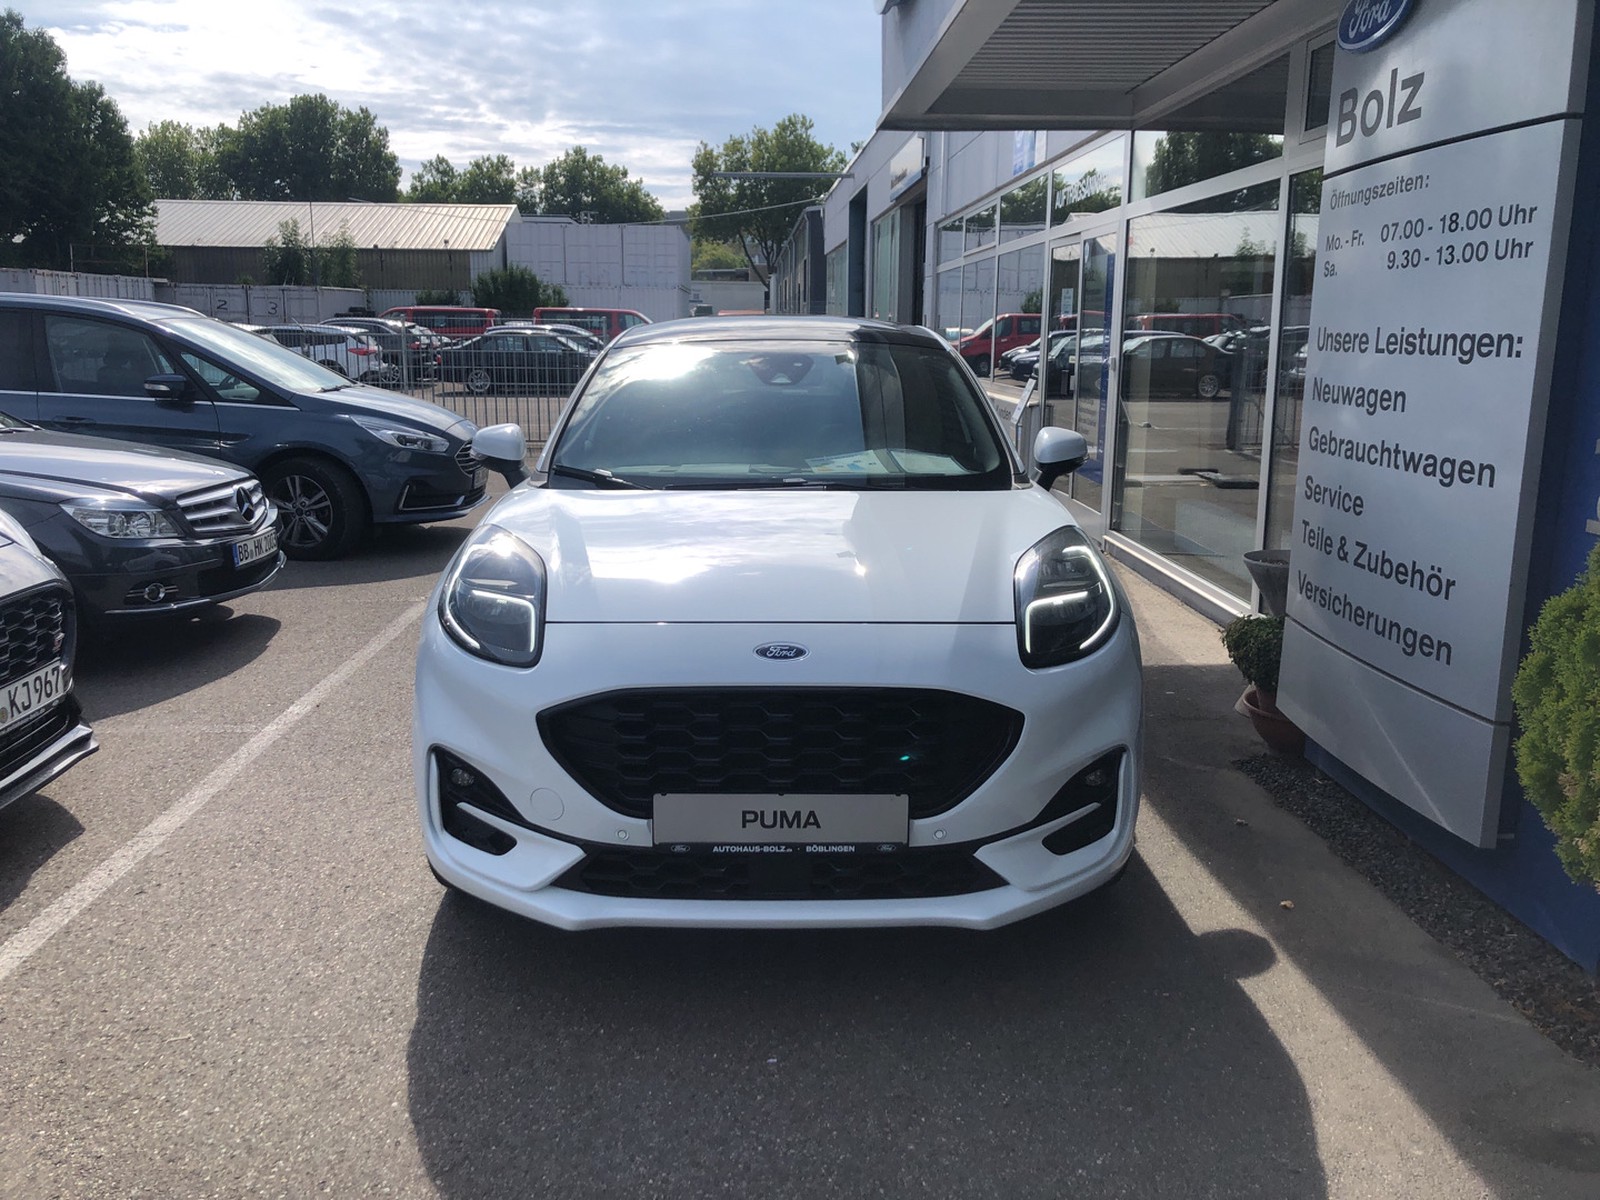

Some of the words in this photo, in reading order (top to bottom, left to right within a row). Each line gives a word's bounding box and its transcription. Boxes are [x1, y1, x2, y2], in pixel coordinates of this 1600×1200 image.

[1335, 67, 1425, 148] Bolz
[1330, 174, 1430, 210] Öffnungszeiten:
[1380, 217, 1425, 243] 07.00
[1439, 207, 1493, 235] 18.00
[1498, 204, 1538, 227] Uhr
[1323, 260, 1338, 278] Sa.
[1386, 249, 1421, 270] 9.30
[1436, 241, 1489, 267] 13.00
[1494, 238, 1534, 260] Uhr
[216, 299, 228, 311] 2
[267, 301, 279, 316] 3
[1316, 326, 1370, 354] Unsere
[1374, 326, 1523, 366] Leistungen:
[1311, 376, 1407, 417] Neuwagen
[1308, 425, 1496, 489] Gebrauchtwagen
[1304, 474, 1365, 517] Service
[238, 543, 250, 562] BB
[1301, 519, 1334, 556] Teile
[1336, 536, 1350, 563] &
[1353, 540, 1457, 601] Zubehör
[1297, 569, 1453, 666] Versicherungen
[766, 645, 798, 658] Ford
[741, 810, 822, 829] PUMA
[805, 844, 856, 853] BÖBLINGEN
